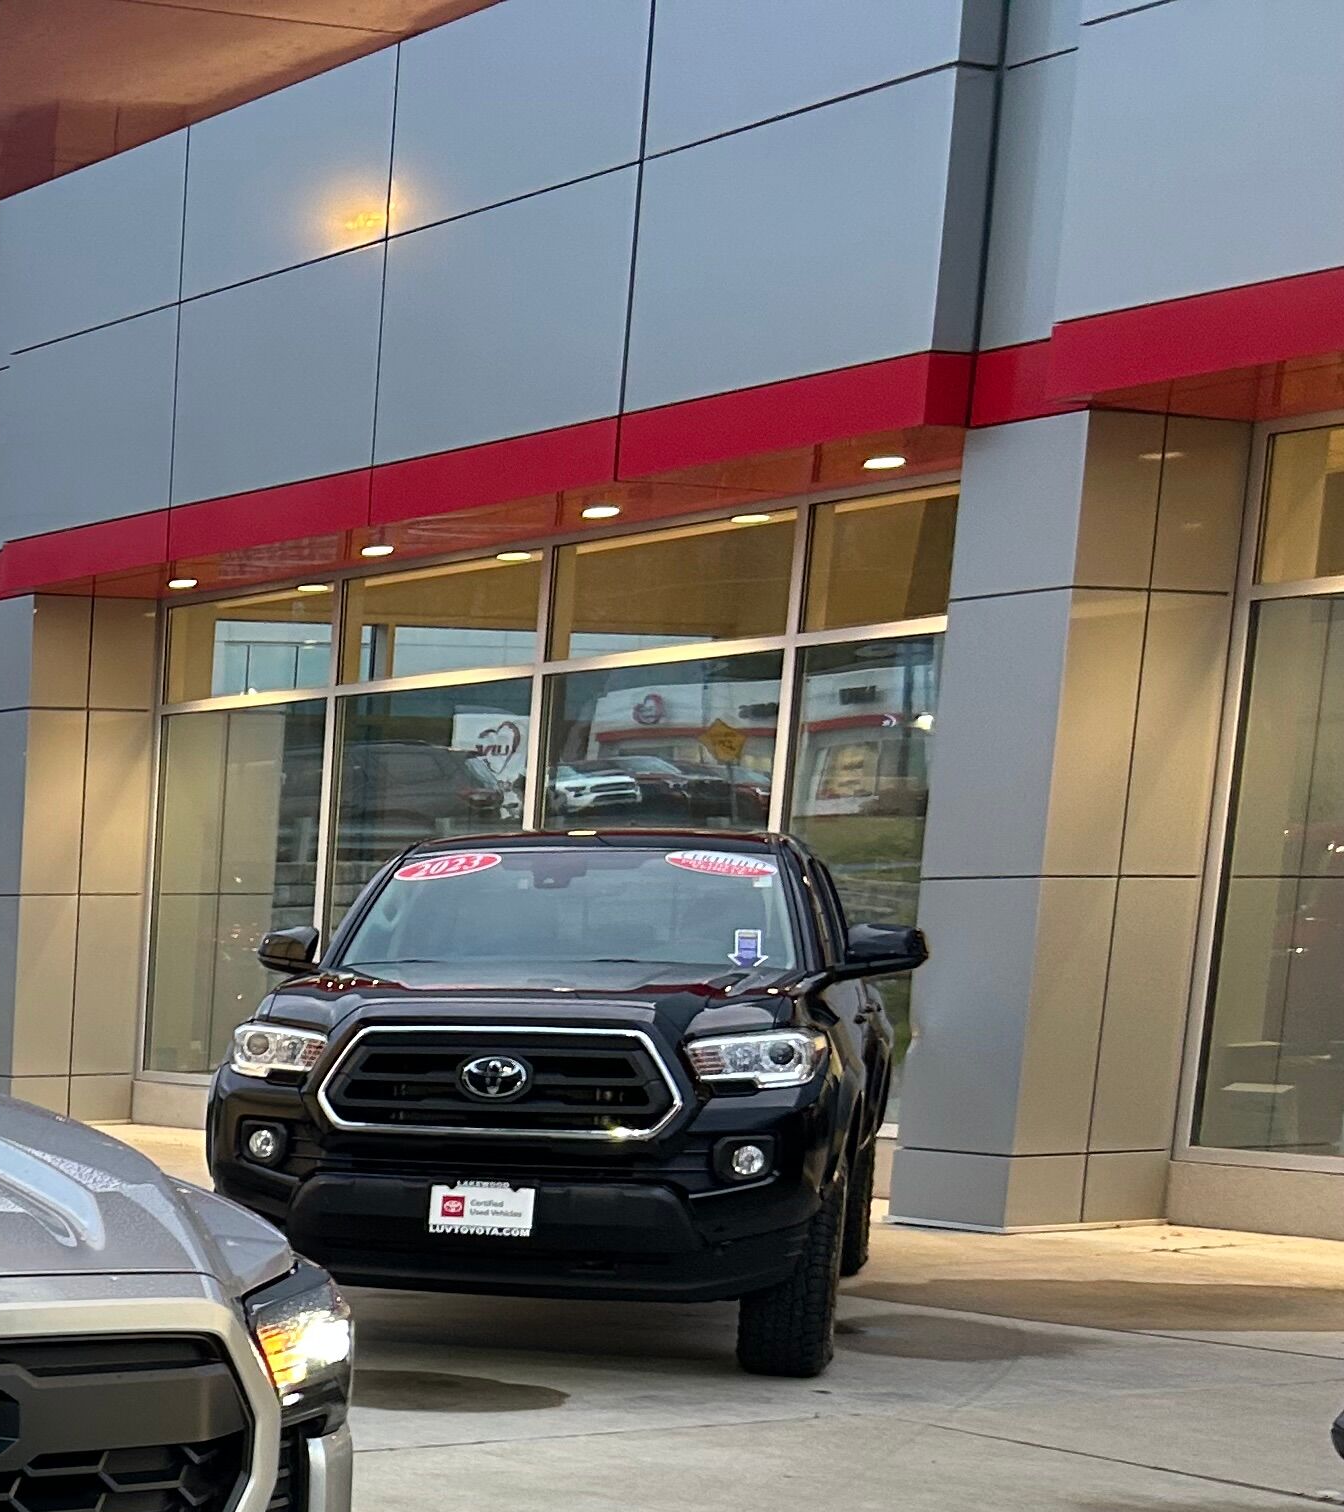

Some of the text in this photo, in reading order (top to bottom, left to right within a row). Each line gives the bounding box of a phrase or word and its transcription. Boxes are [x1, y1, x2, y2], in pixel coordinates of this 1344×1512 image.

[411, 855, 484, 877] 2023
[470, 1199, 504, 1208] Certified
[469, 1208, 522, 1217] Used Vehicles
[428, 1224, 531, 1237] LUVTOYOTA.COM
